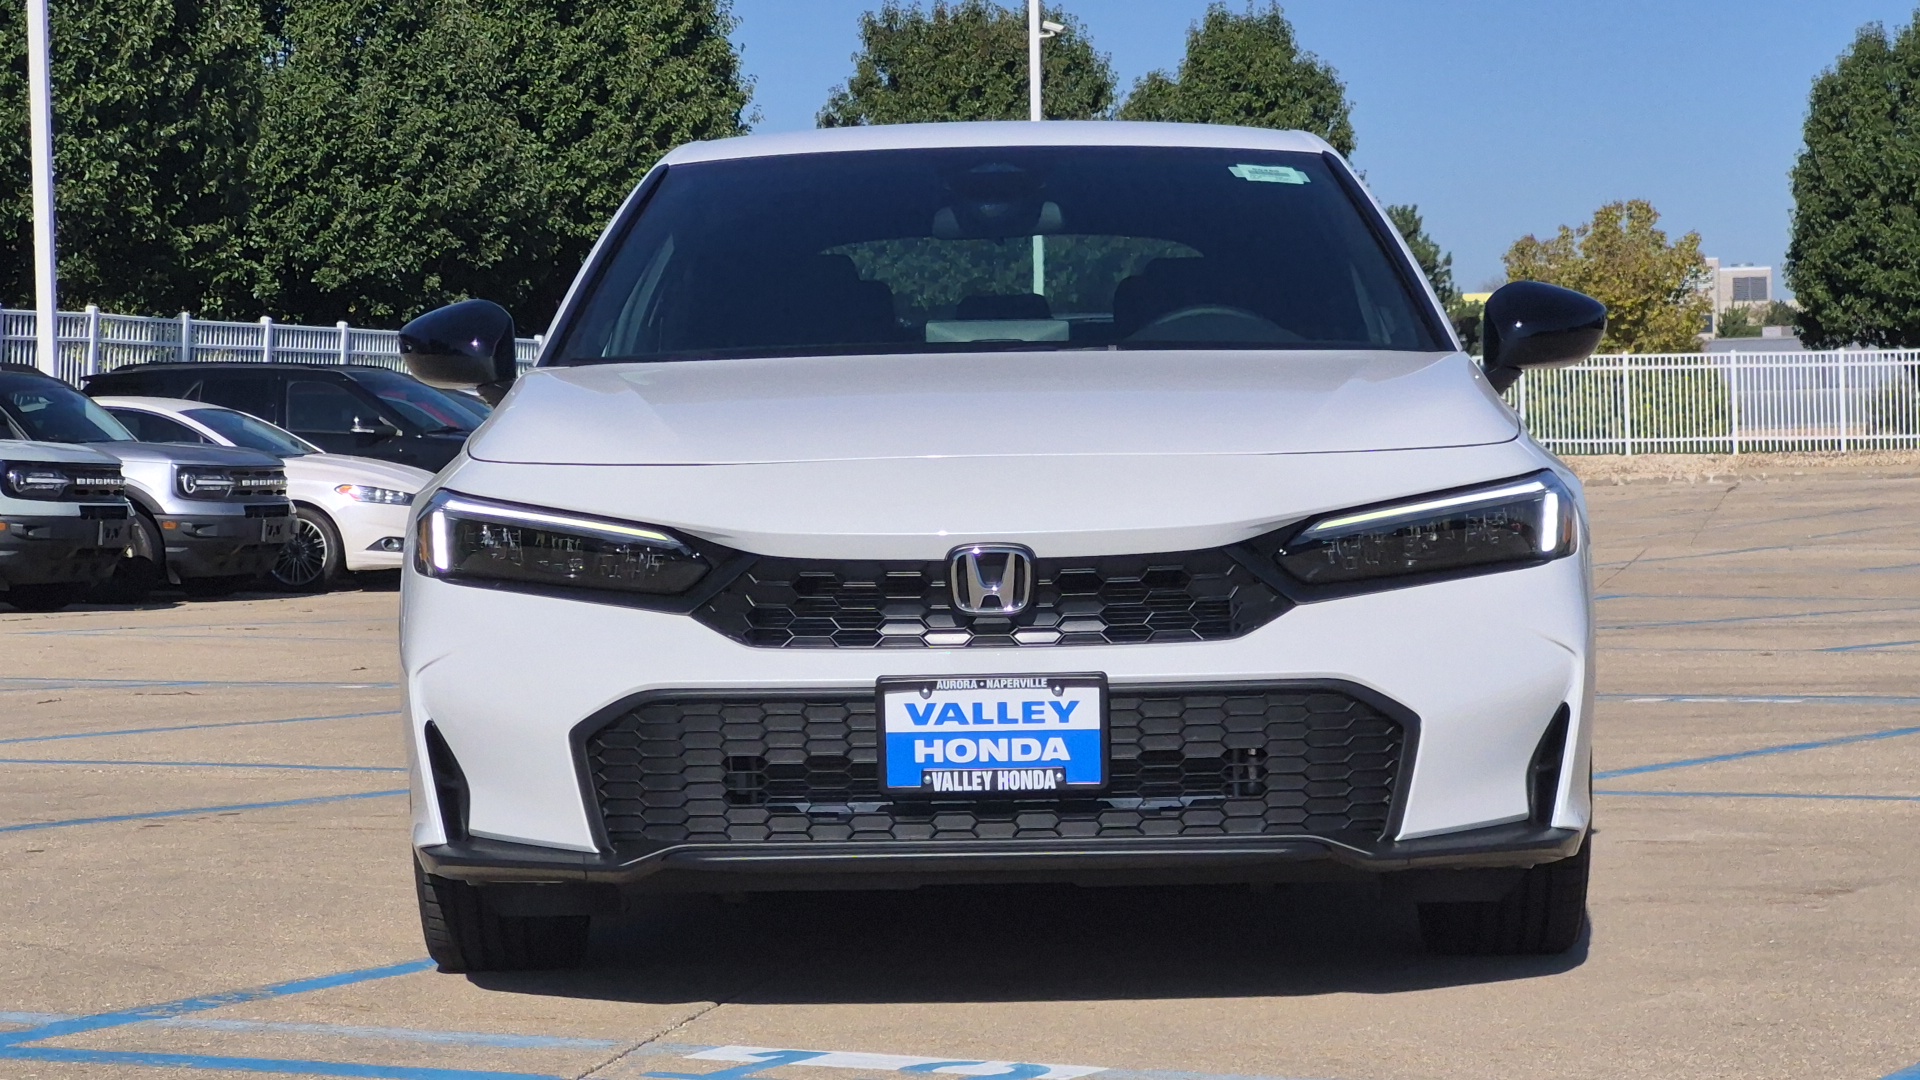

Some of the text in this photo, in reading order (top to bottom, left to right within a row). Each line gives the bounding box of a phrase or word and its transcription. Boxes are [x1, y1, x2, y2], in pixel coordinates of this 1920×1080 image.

[936, 678, 1048, 690] AURORA NAPERVILLE
[904, 701, 1080, 725] VALLEY
[914, 737, 1071, 763] HONDA
[932, 769, 1056, 792] VALLEY HONDA
